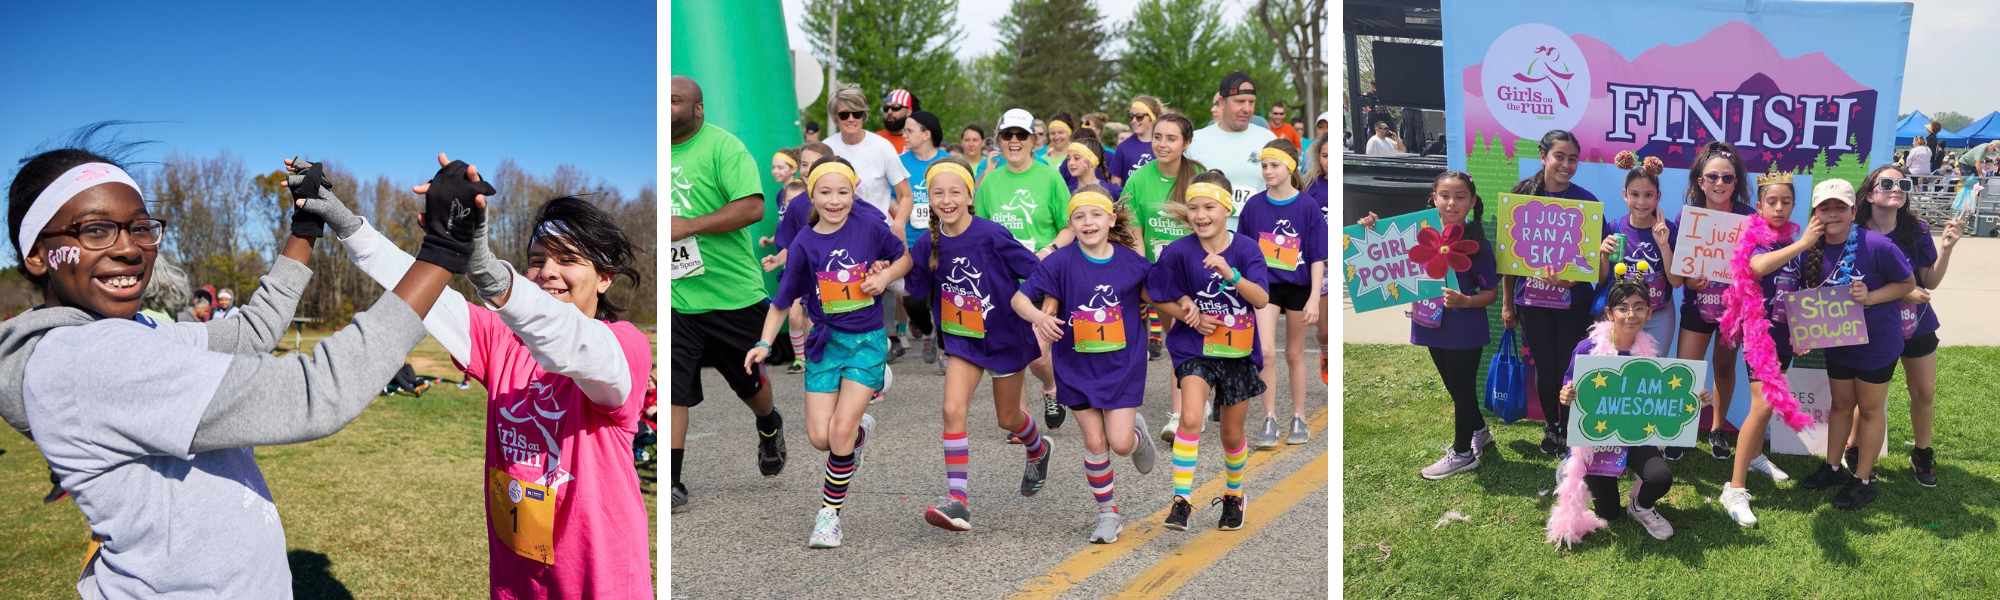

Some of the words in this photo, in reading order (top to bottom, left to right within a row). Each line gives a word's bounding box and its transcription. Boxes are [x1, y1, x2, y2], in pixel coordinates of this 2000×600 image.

[1497, 86, 1542, 102] Girls
[1507, 103, 1520, 111] the
[1520, 103, 1554, 115] run
[1606, 84, 1858, 150] FINISH
[1523, 211, 1529, 224] I
[1536, 211, 1577, 227] JUST
[1522, 227, 1556, 241] RAN
[1561, 230, 1573, 244] A
[1685, 211, 1709, 239] I
[1705, 223, 1744, 246] just
[1274, 248, 1281, 260] 1
[1367, 238, 1410, 261] GIRL
[1530, 245, 1565, 265] 5K!
[1694, 245, 1725, 259] ran
[1359, 257, 1427, 287] POWE
[841, 286, 850, 300] 1
[1194, 299, 1222, 311] irls
[1801, 291, 1855, 319] Star
[955, 311, 962, 325] 1
[1097, 326, 1105, 341] 1
[1225, 331, 1232, 346] 1
[1792, 321, 1863, 347] power
[1621, 376, 1627, 393] I
[1636, 378, 1662, 395] AM
[1595, 397, 1684, 417] AWESOME!
[503, 445, 542, 468] run
[510, 506, 518, 533] 1
